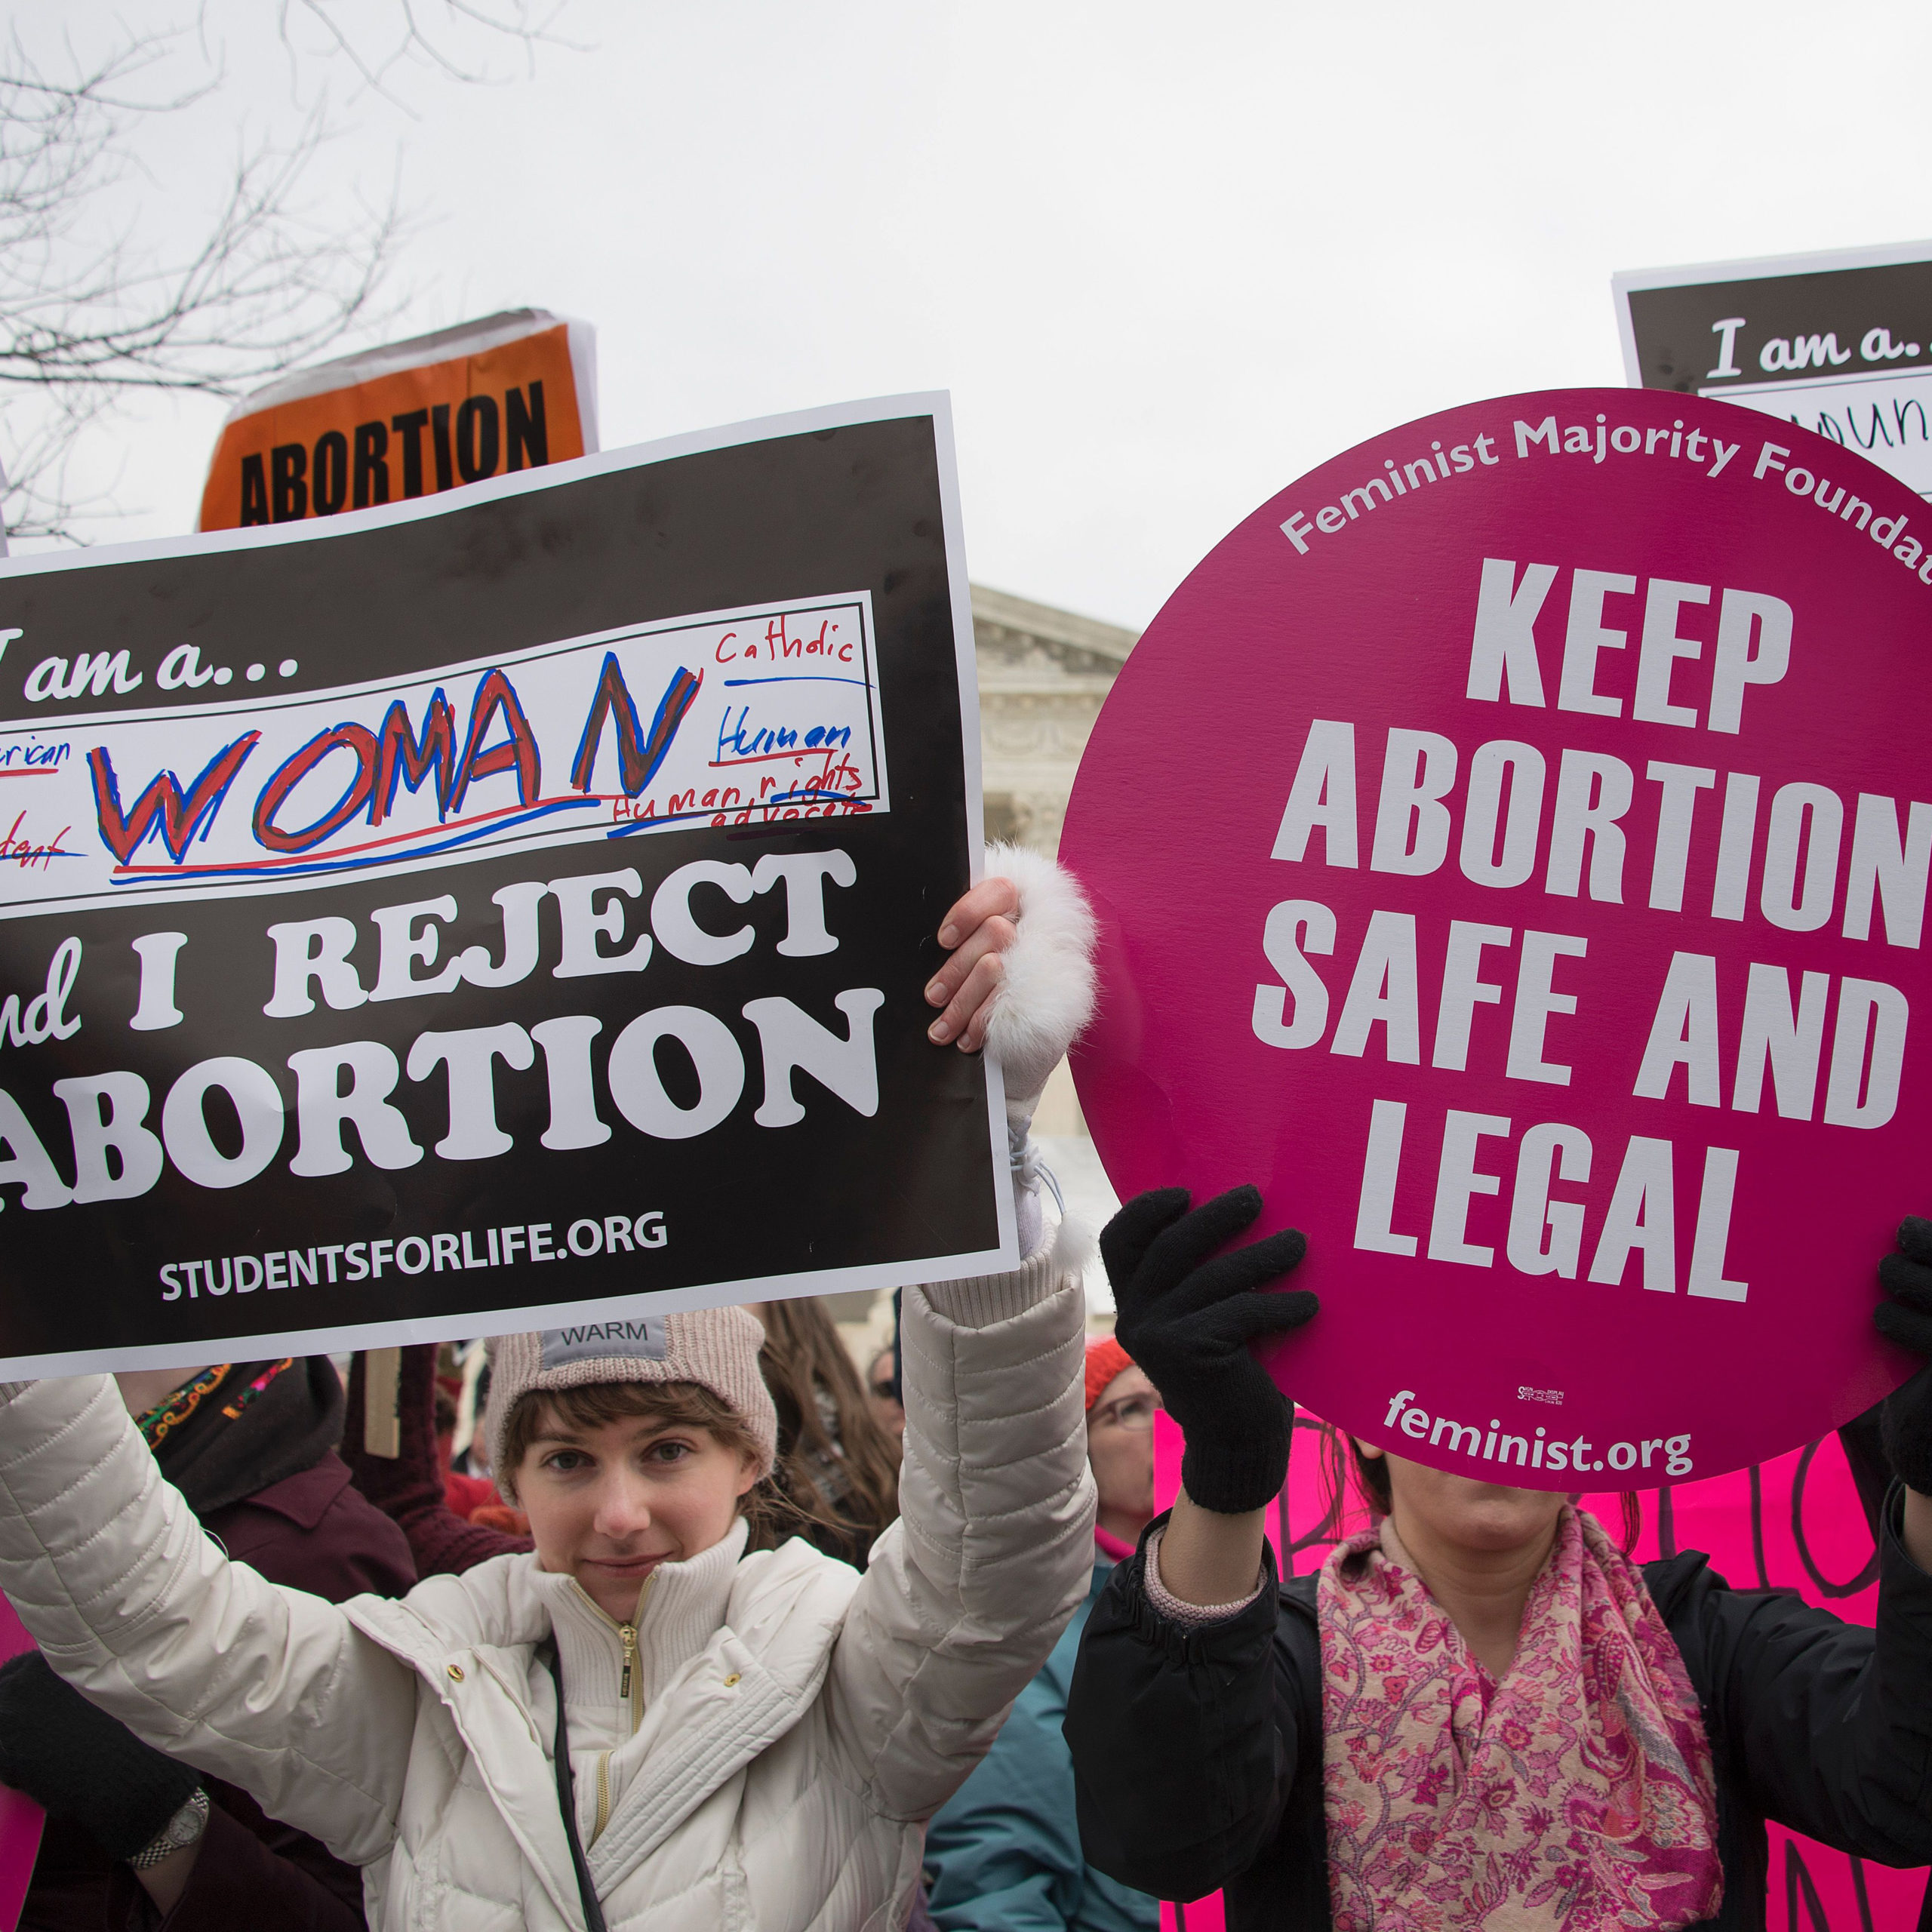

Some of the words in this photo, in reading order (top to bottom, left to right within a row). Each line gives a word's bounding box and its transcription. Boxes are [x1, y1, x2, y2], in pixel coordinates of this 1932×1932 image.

[1706, 318, 1746, 378] I
[1760, 332, 1851, 372] am
[240, 380, 549, 527] ABORTION
[1279, 432, 1500, 555] Feminist
[1513, 414, 1741, 478] Majority
[24, 651, 142, 702] am
[156, 644, 298, 690] a...
[715, 615, 853, 665] Catholic
[1466, 558, 1793, 735] KEEP
[0, 735, 70, 766] rican
[86, 651, 704, 865] WOMAN
[716, 706, 851, 763] Human
[760, 752, 863, 806] rights
[1270, 719, 1932, 949] ABORTION
[130, 931, 188, 1031] I
[263, 848, 857, 1018] REJECT
[1251, 900, 1588, 1086] SAFE
[1632, 951, 1910, 1130] AND
[0, 988, 885, 1211] ABORTION
[159, 1211, 668, 1300] STUDENTSFORLIFE.ORG
[1354, 1099, 1749, 1303] LEGAL
[561, 1321, 648, 1346] WARM
[1383, 1390, 1694, 1476] feminist.org
